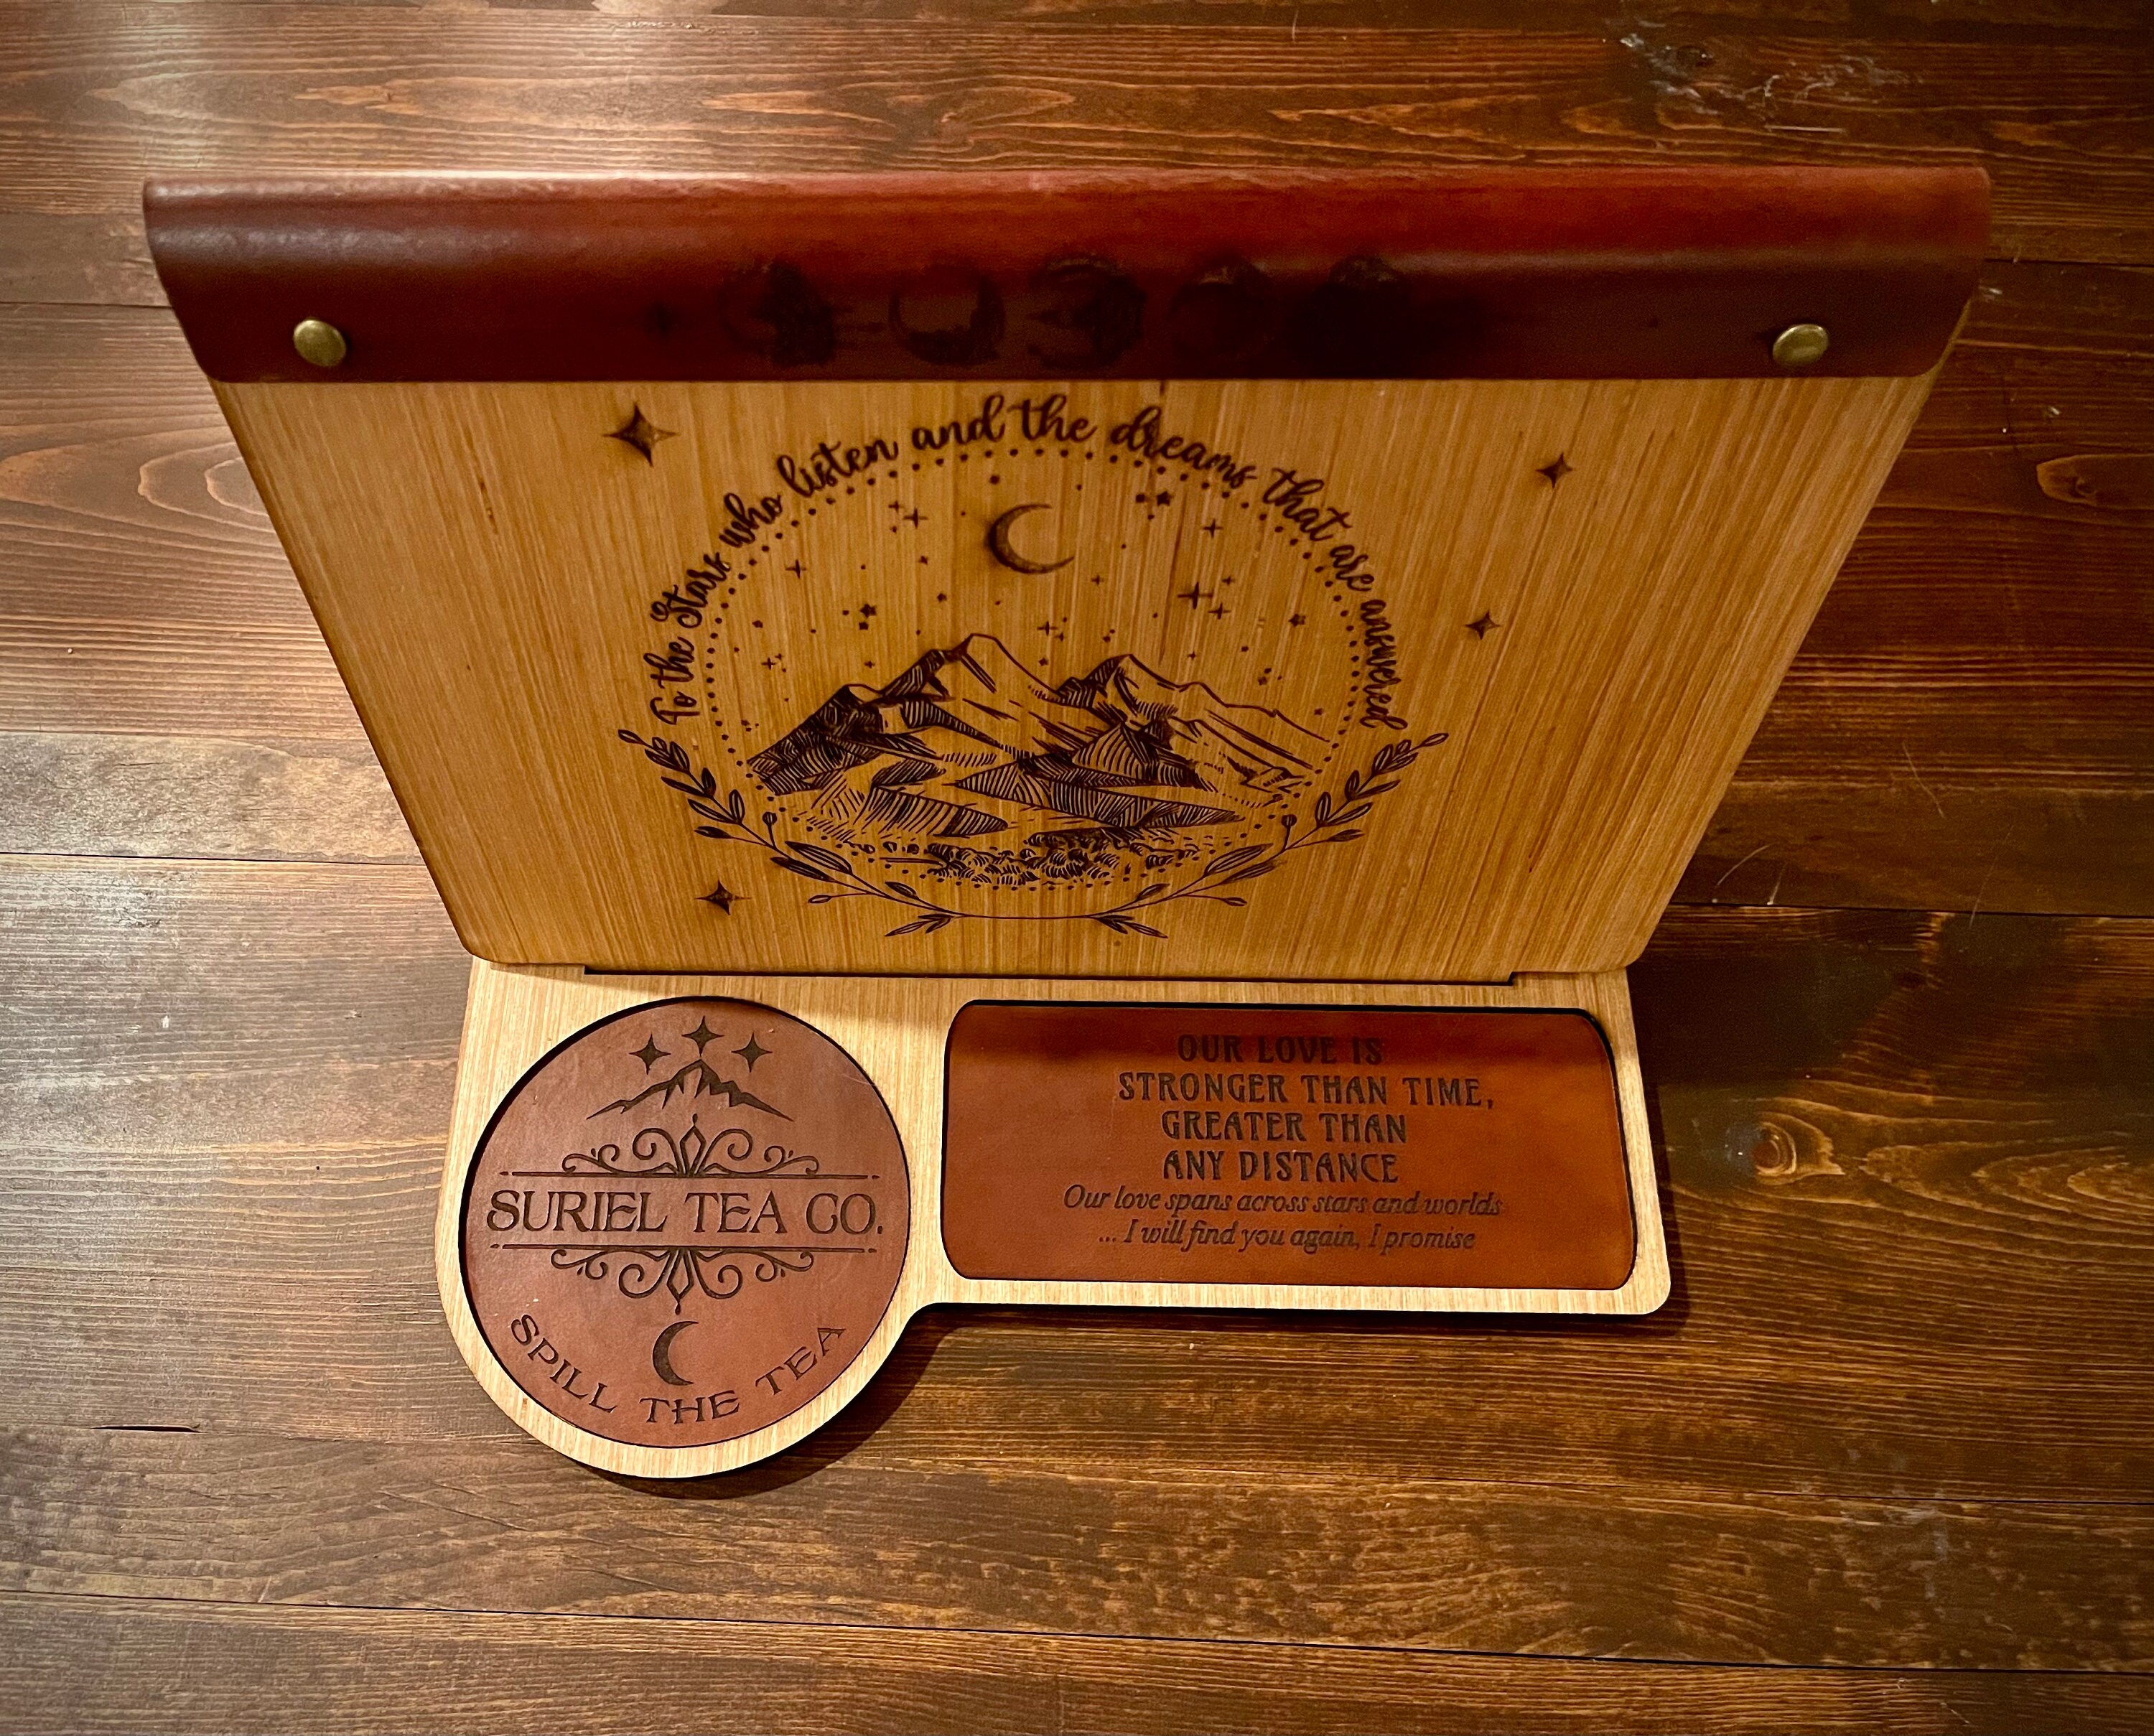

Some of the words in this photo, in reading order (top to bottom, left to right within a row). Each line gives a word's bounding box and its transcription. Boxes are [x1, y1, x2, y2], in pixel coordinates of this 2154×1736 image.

[910, 394, 1005, 452] and
[1007, 393, 1098, 442] the
[775, 437, 899, 498] listen
[1110, 406, 1257, 489] dreams
[719, 492, 783, 549] who
[1262, 467, 1352, 542] that
[650, 551, 731, 629] Stars
[1329, 543, 1375, 592] are
[643, 637, 694, 690] the
[1359, 599, 1408, 731] answered
[651, 691, 701, 725] To
[1177, 1034, 1243, 1063] OUR
[1257, 1037, 1336, 1064] LOVE
[1351, 1037, 1383, 1065] IS
[1118, 1072, 1286, 1103] STRONGER
[1301, 1075, 1386, 1105] THAN
[1402, 1078, 1494, 1109] TIME,
[1160, 1111, 1305, 1141] GREATER
[1318, 1114, 1406, 1142] THAN
[1162, 1150, 1224, 1180] ANY
[1239, 1151, 1398, 1182] DISTANCE
[486, 1189, 668, 1234] SURIEL
[684, 1190, 788, 1235] TEA
[806, 1193, 883, 1236] CO.
[1064, 1185, 1110, 1208] Our
[1114, 1186, 1160, 1209] love
[1165, 1190, 1231, 1216] spans
[1236, 1195, 1307, 1212] across
[1312, 1195, 1367, 1213] stars
[1372, 1192, 1419, 1214] and
[1425, 1192, 1503, 1215] worlds
[1124, 1218, 1137, 1243] I
[1141, 1220, 1185, 1243] will
[1182, 1220, 1235, 1252] find
[1239, 1226, 1285, 1252] you
[1290, 1224, 1360, 1252] again,
[1368, 1223, 1381, 1246] I
[1381, 1226, 1475, 1255] promise
[510, 1314, 617, 1414] SPILL
[640, 1389, 740, 1425] THE
[755, 1326, 847, 1396] TEA
